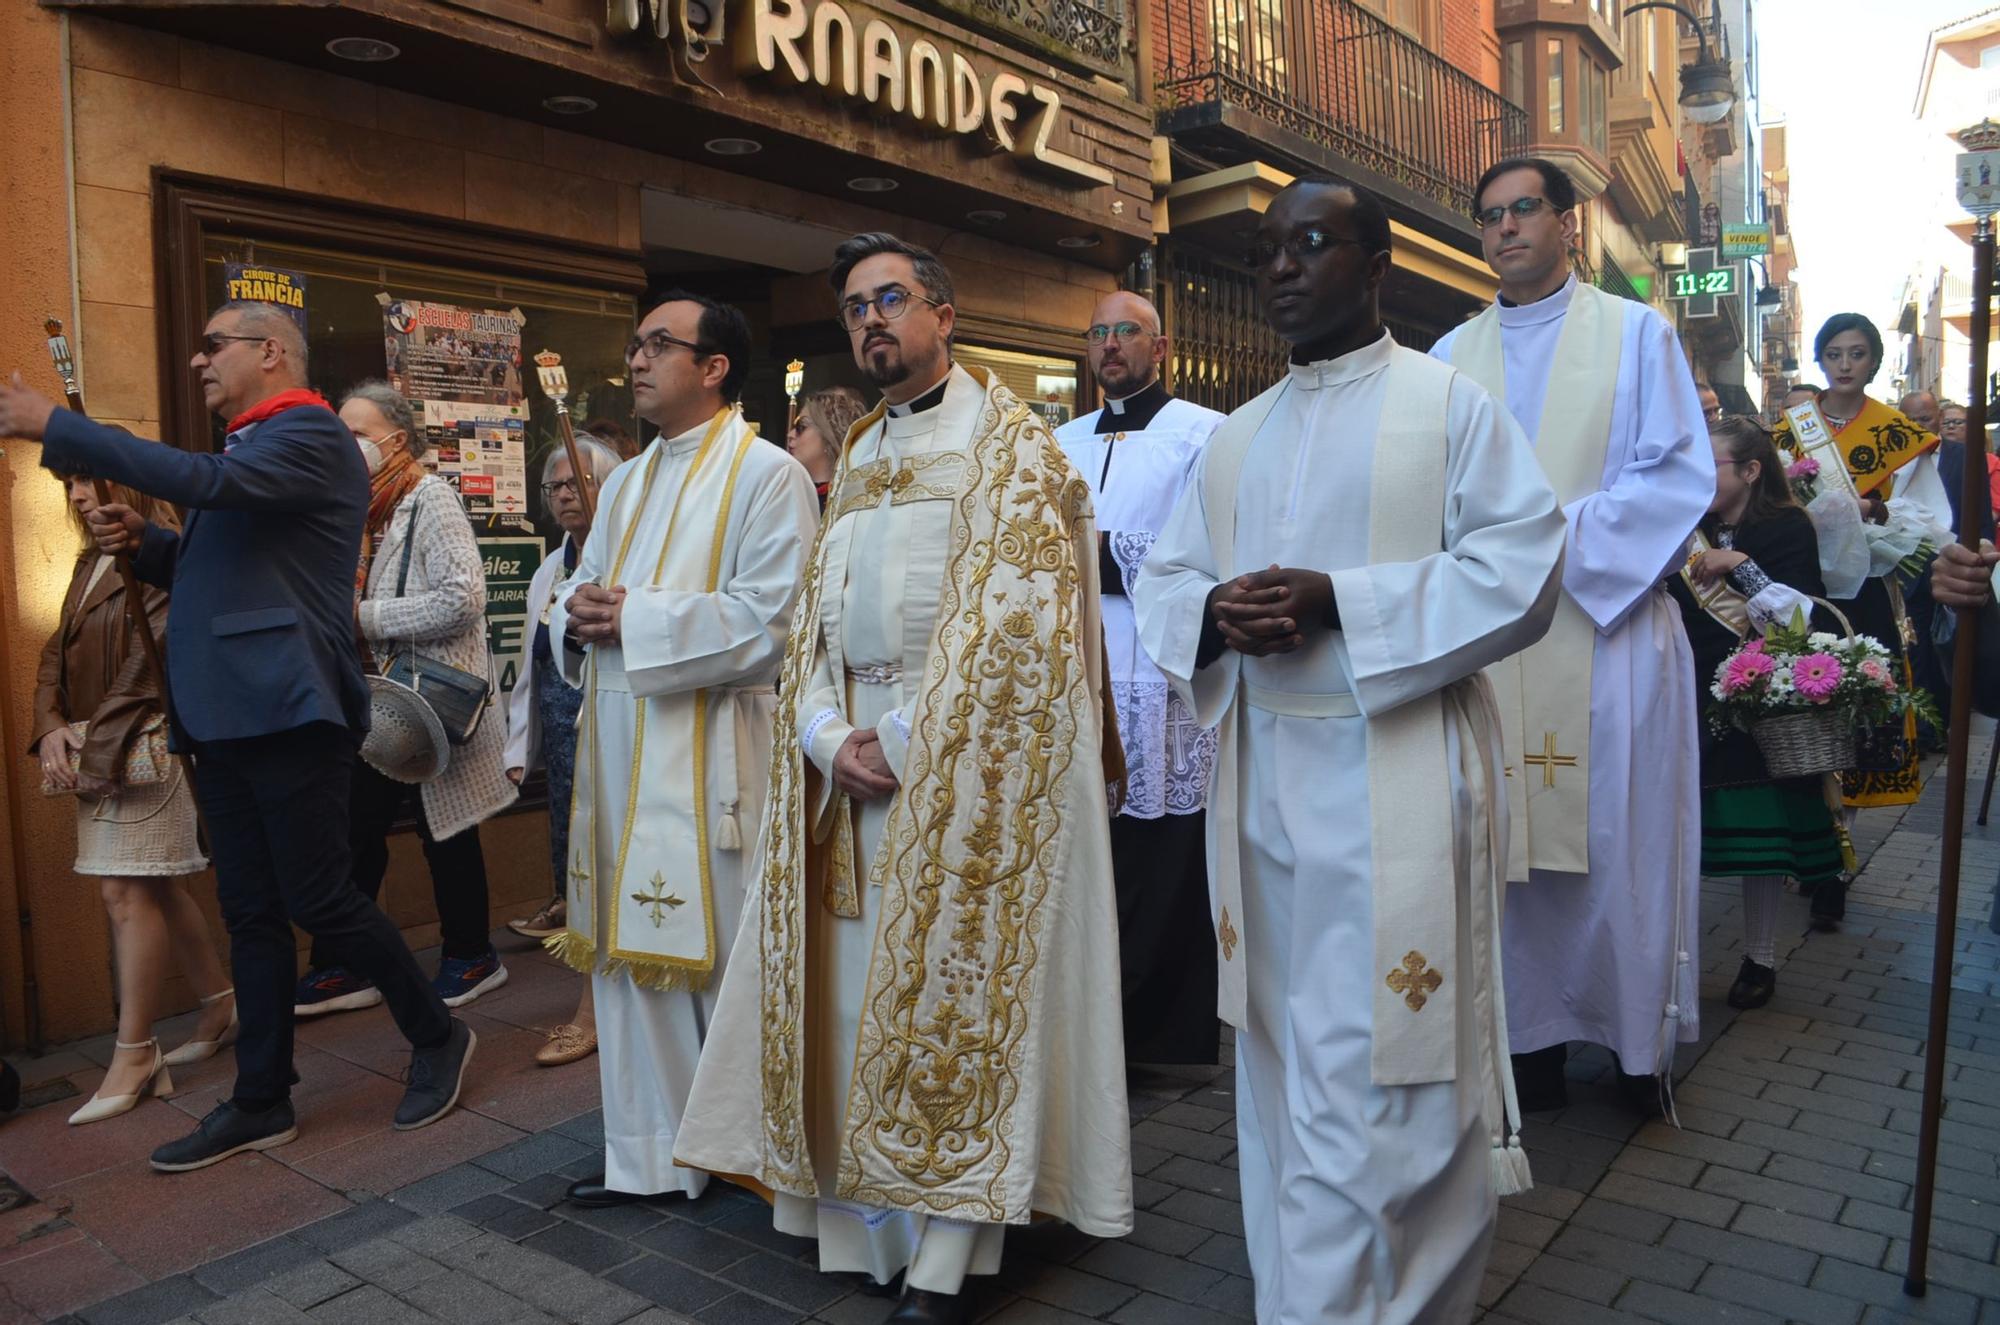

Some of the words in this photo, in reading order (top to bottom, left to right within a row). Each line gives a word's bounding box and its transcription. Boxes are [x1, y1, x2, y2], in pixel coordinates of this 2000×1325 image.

[626, 0, 1115, 186] RNANDEZ
[1728, 233, 1761, 243] VENDE
[242, 268, 276, 282] CIRQUE
[278, 273, 290, 285] DE
[1675, 271, 1729, 296] 11:22
[229, 279, 304, 308] FRANCIA
[417, 307, 471, 331] ESCUELAS
[471, 312, 519, 336] TAURINAS
[483, 555, 521, 576] ález
